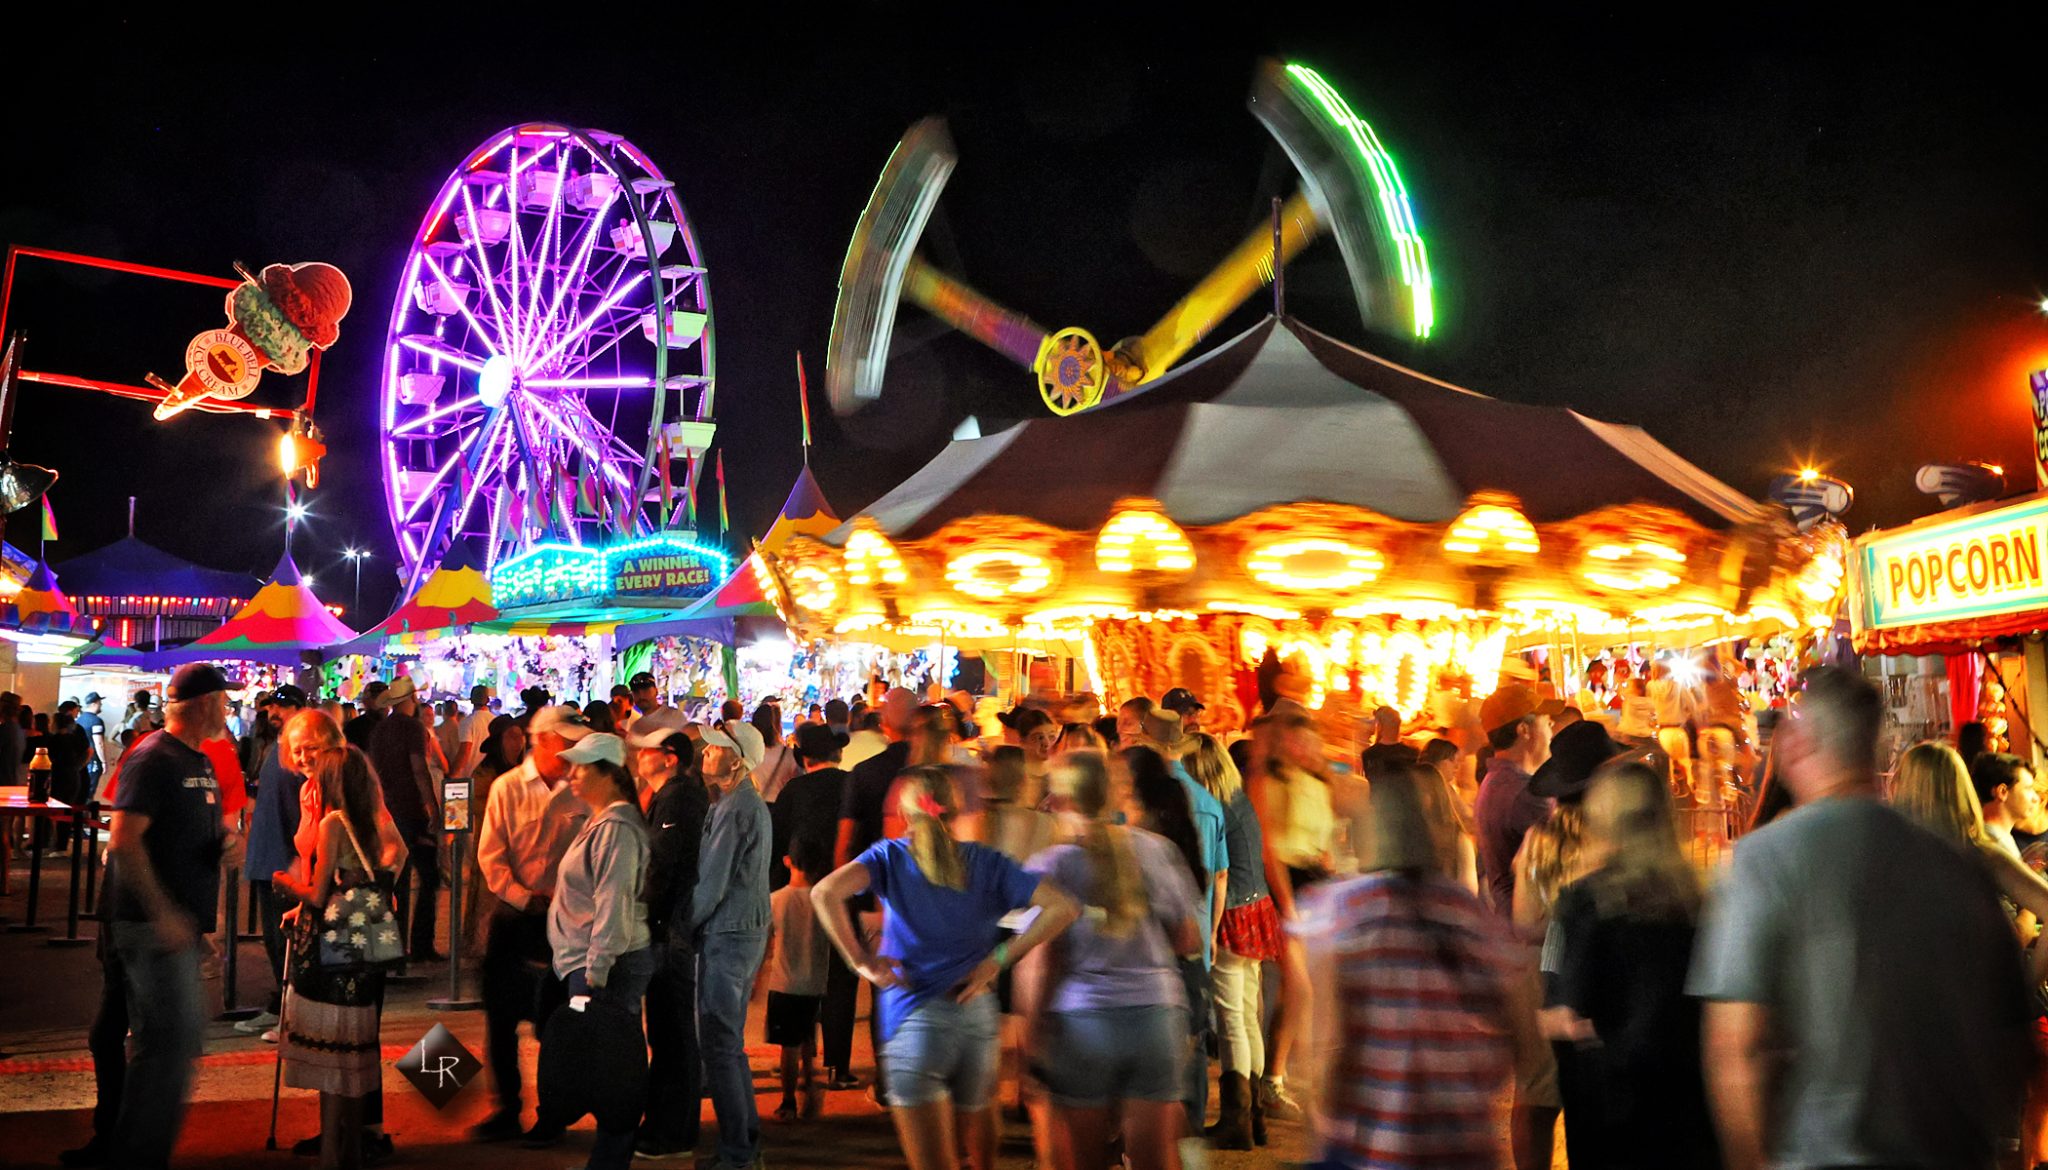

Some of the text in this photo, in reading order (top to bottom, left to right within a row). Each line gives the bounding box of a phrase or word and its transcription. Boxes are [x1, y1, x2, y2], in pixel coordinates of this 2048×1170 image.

[195, 345, 238, 395] ICE CREAM
[215, 333, 258, 378] BLUE BELL
[616, 569, 709, 590] EVERY RACE!
[624, 555, 700, 573] A WINNER
[1889, 529, 2040, 605] POPCORN
